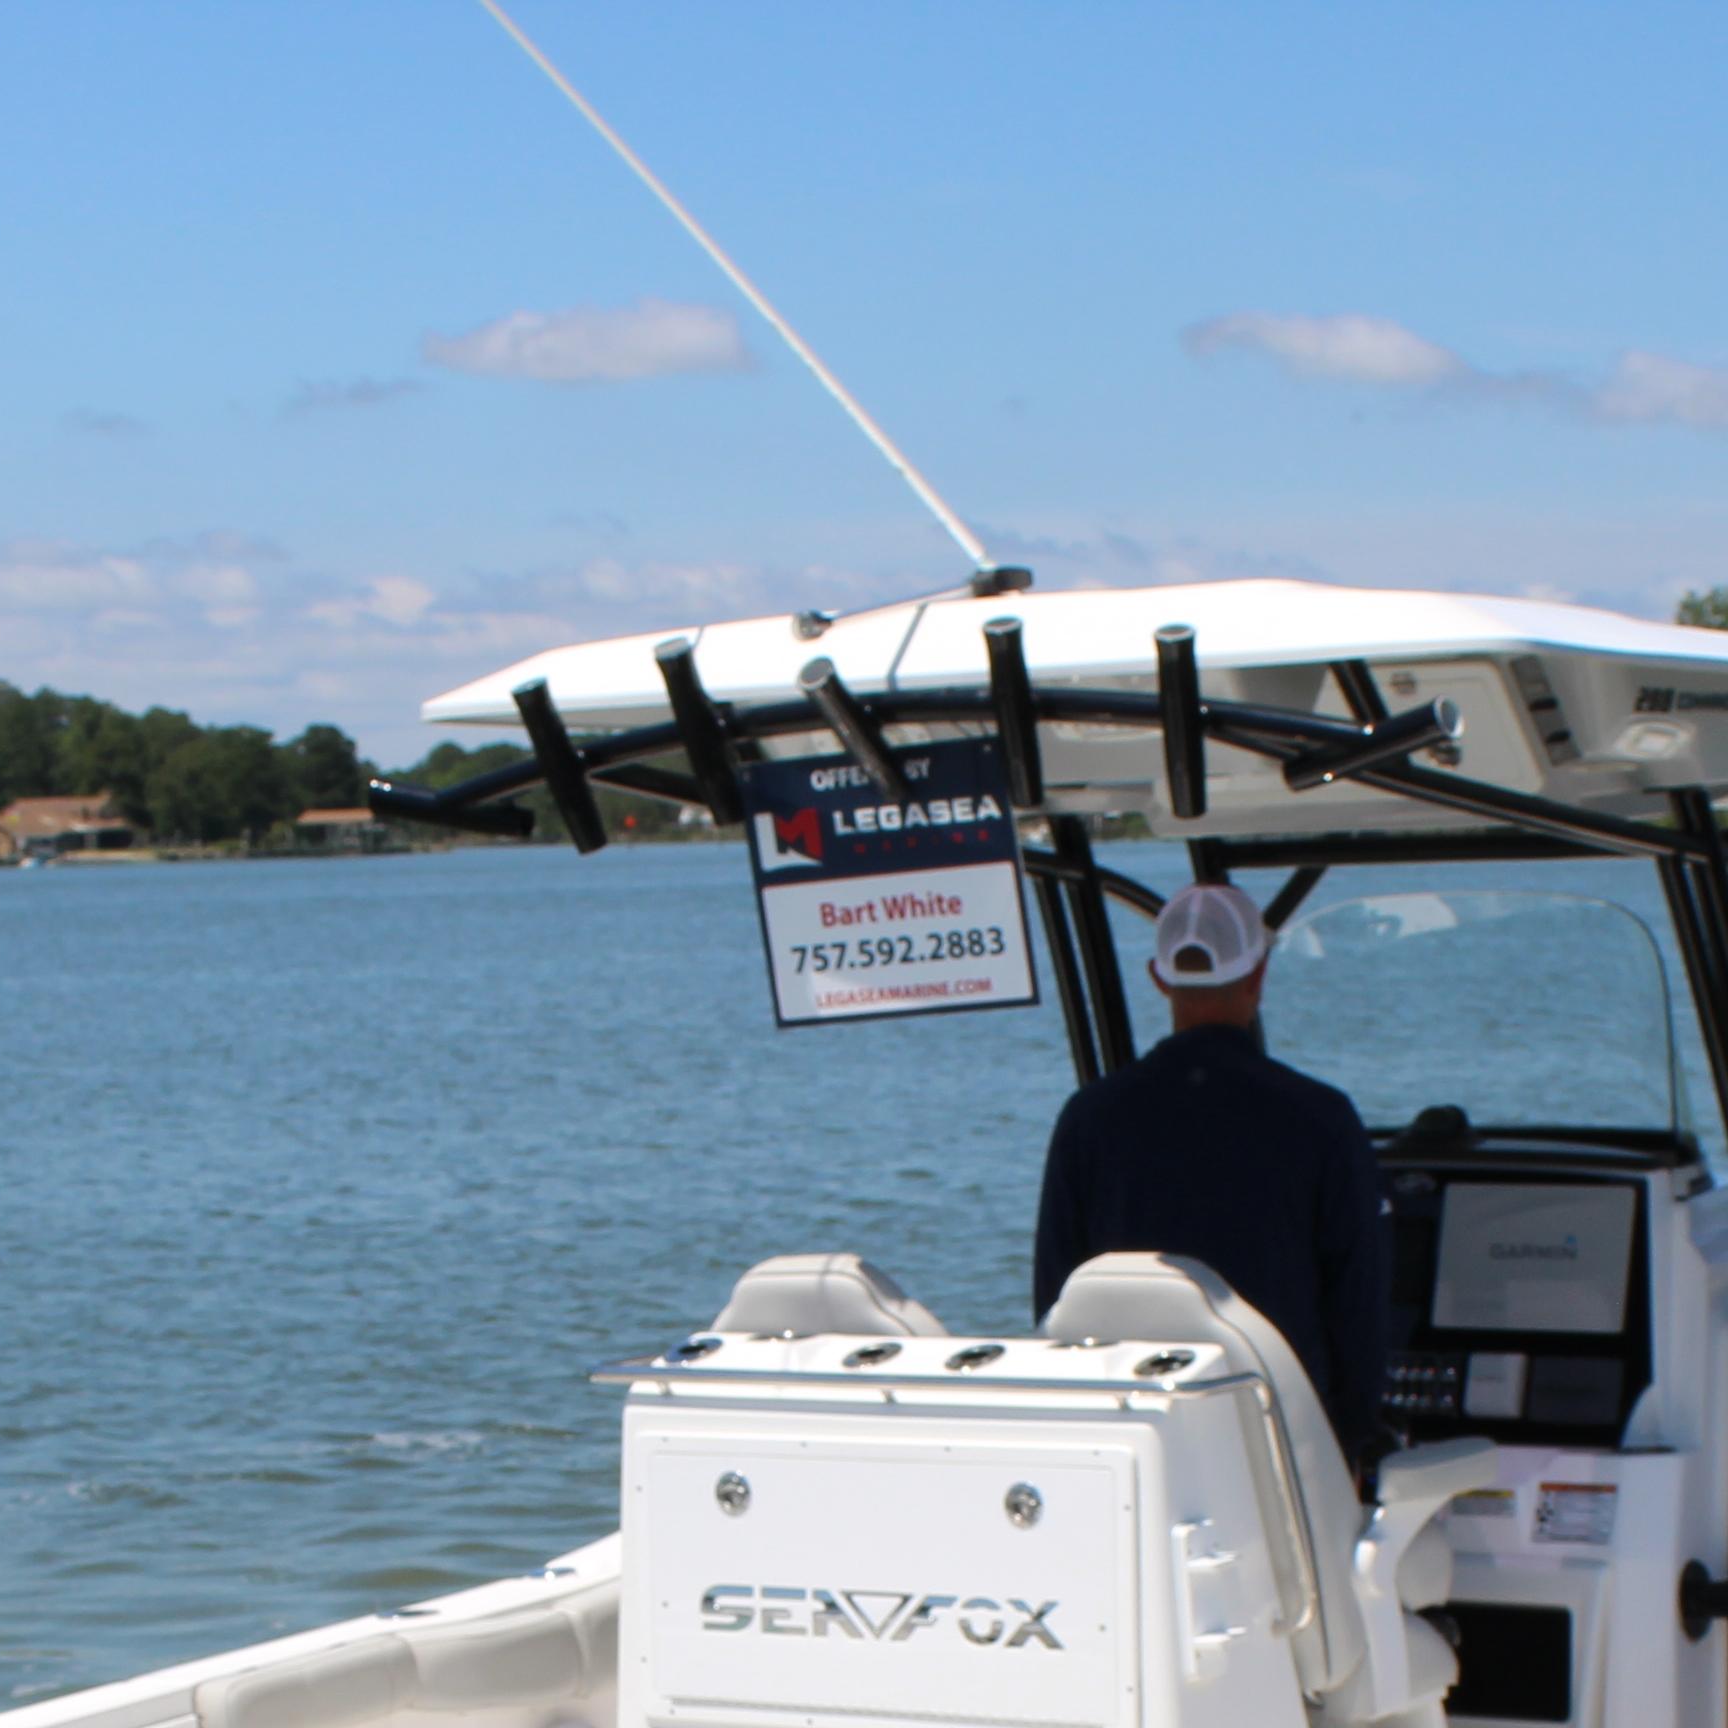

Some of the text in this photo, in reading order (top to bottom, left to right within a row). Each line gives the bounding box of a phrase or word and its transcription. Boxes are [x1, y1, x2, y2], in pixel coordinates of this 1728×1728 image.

[832, 795, 1001, 836] LEGASEA
[819, 892, 962, 928] Bart White
[790, 927, 1005, 973] 757.592.2883
